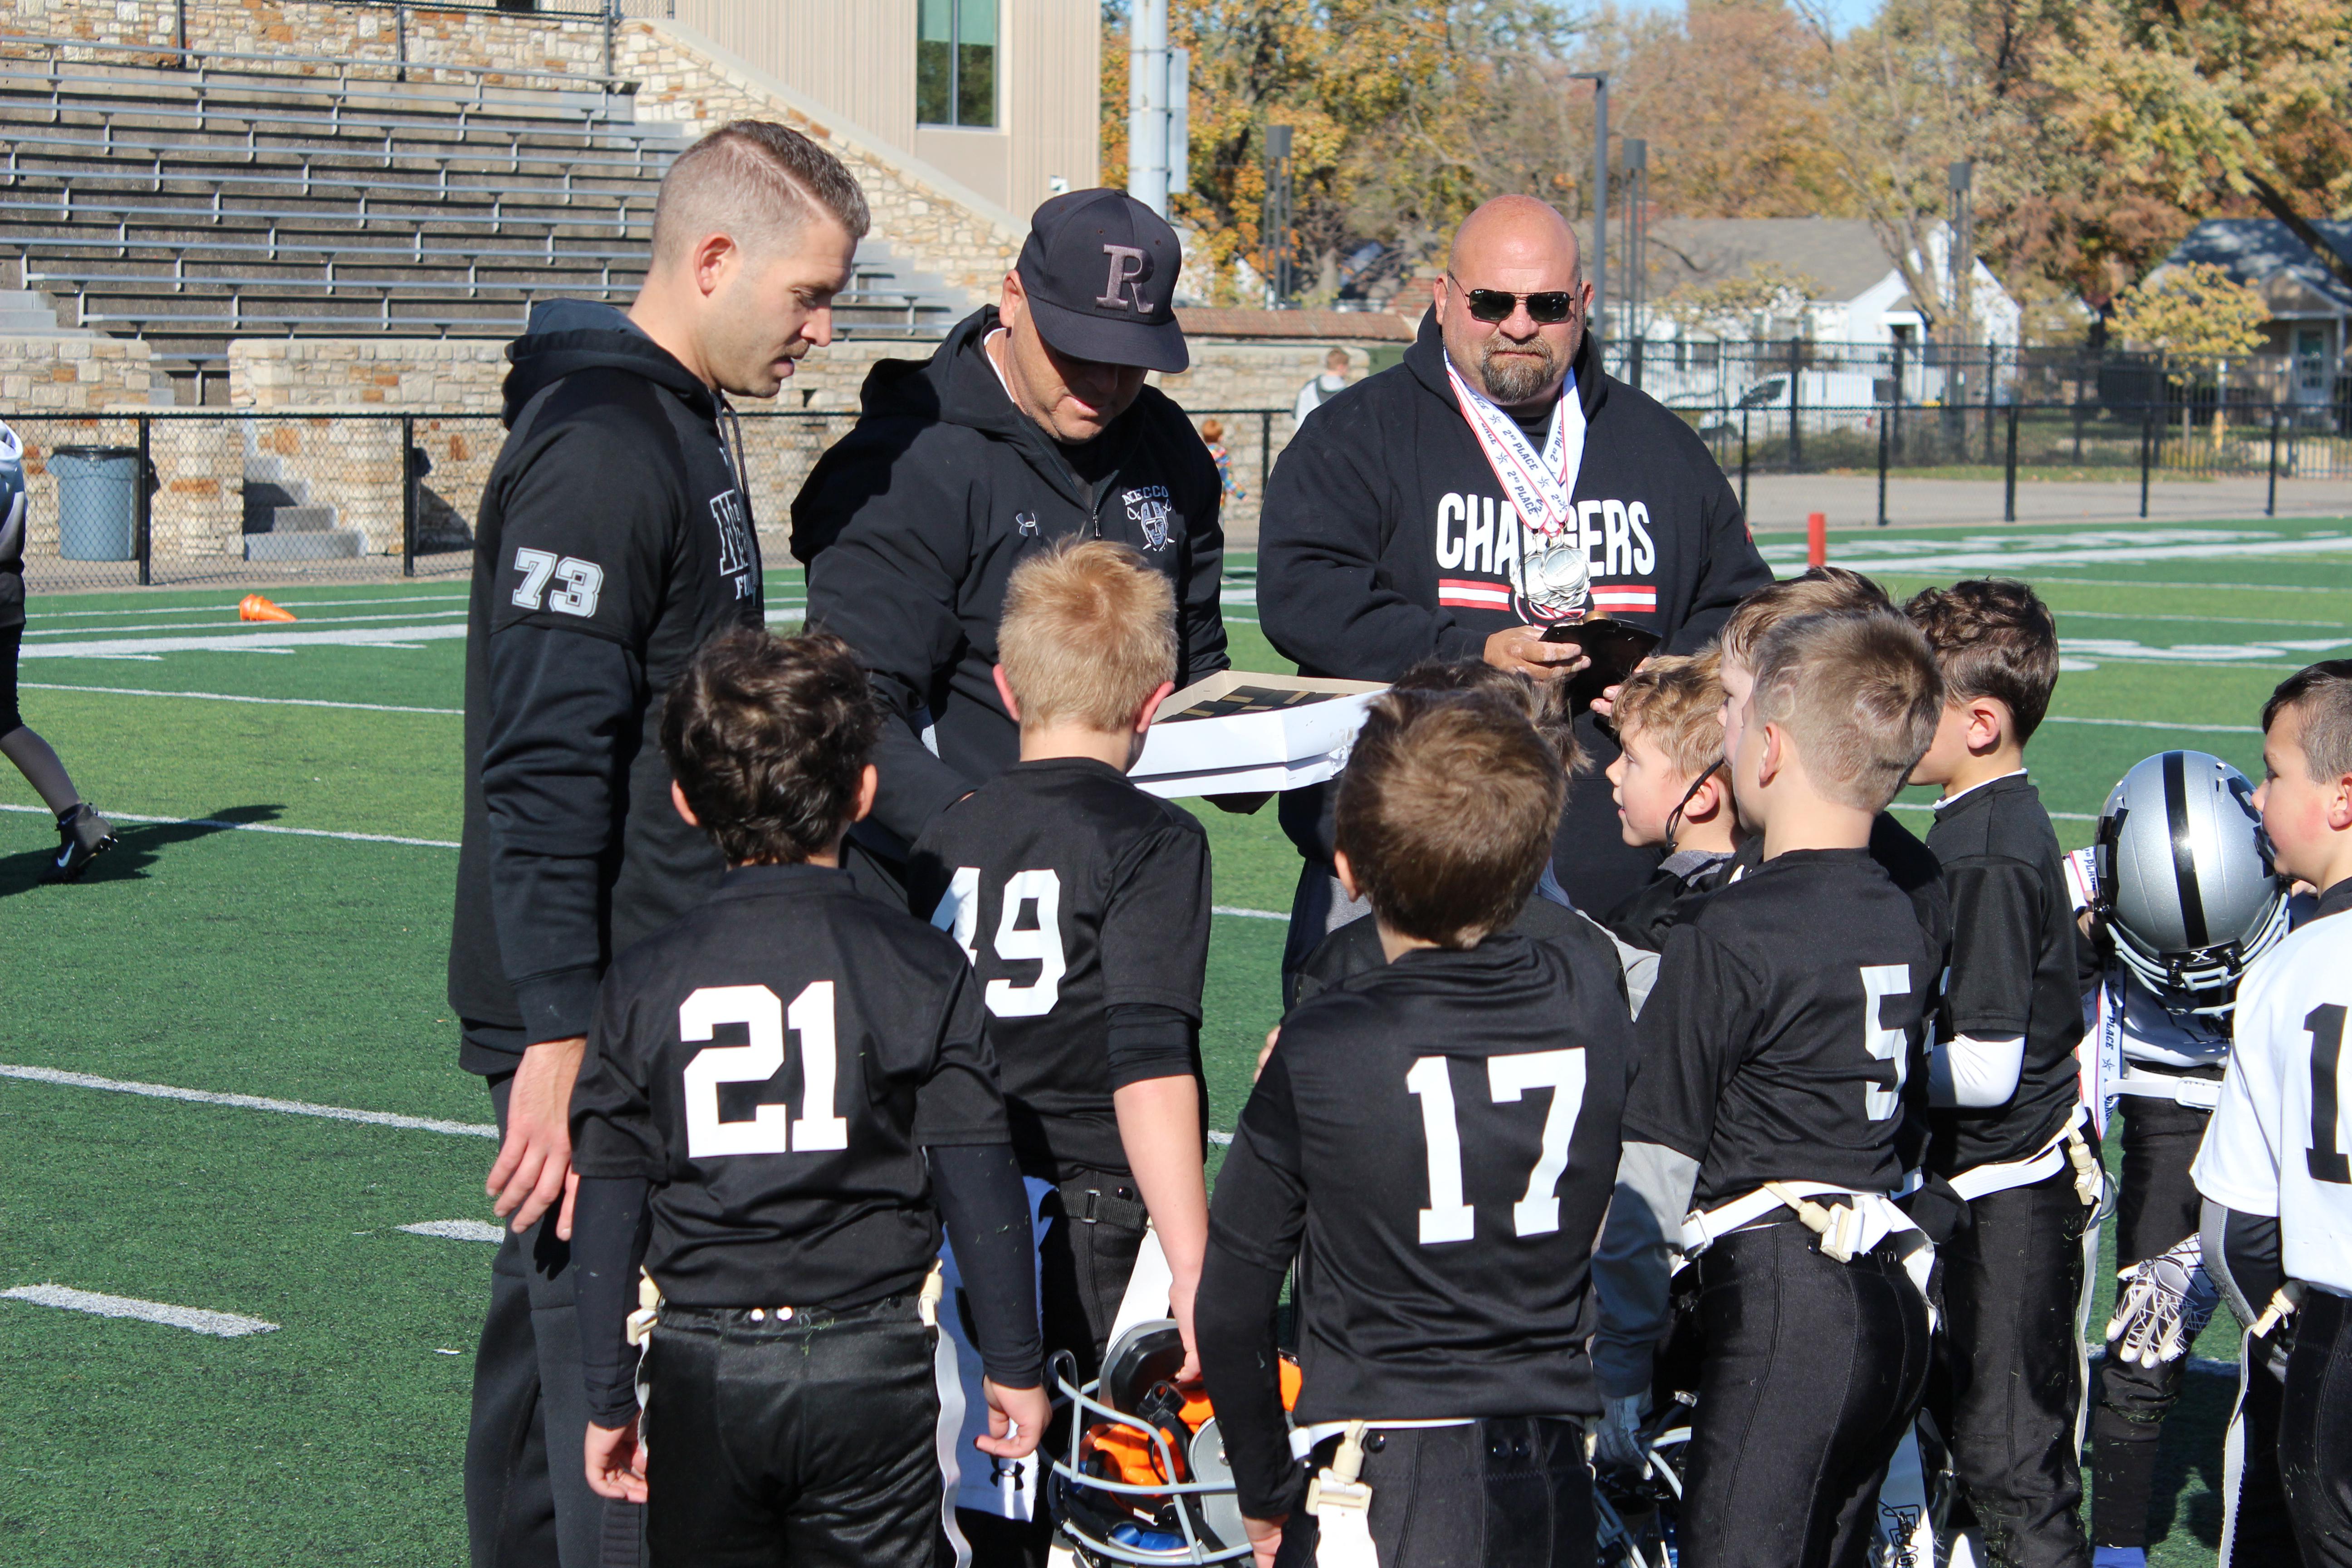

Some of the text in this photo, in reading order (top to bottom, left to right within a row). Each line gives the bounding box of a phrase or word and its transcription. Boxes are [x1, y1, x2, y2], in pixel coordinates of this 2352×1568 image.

[1095, 243, 1155, 314] R
[1513, 442, 1539, 470] PLACE
[1122, 485, 1169, 505] NECCO
[1514, 485, 1538, 515] PLACE
[511, 546, 604, 618] 73
[679, 980, 848, 1158] 21
[1860, 964, 1911, 1121] 5
[2303, 1003, 2352, 1184] 1
[1406, 1047, 1587, 1244] 17
